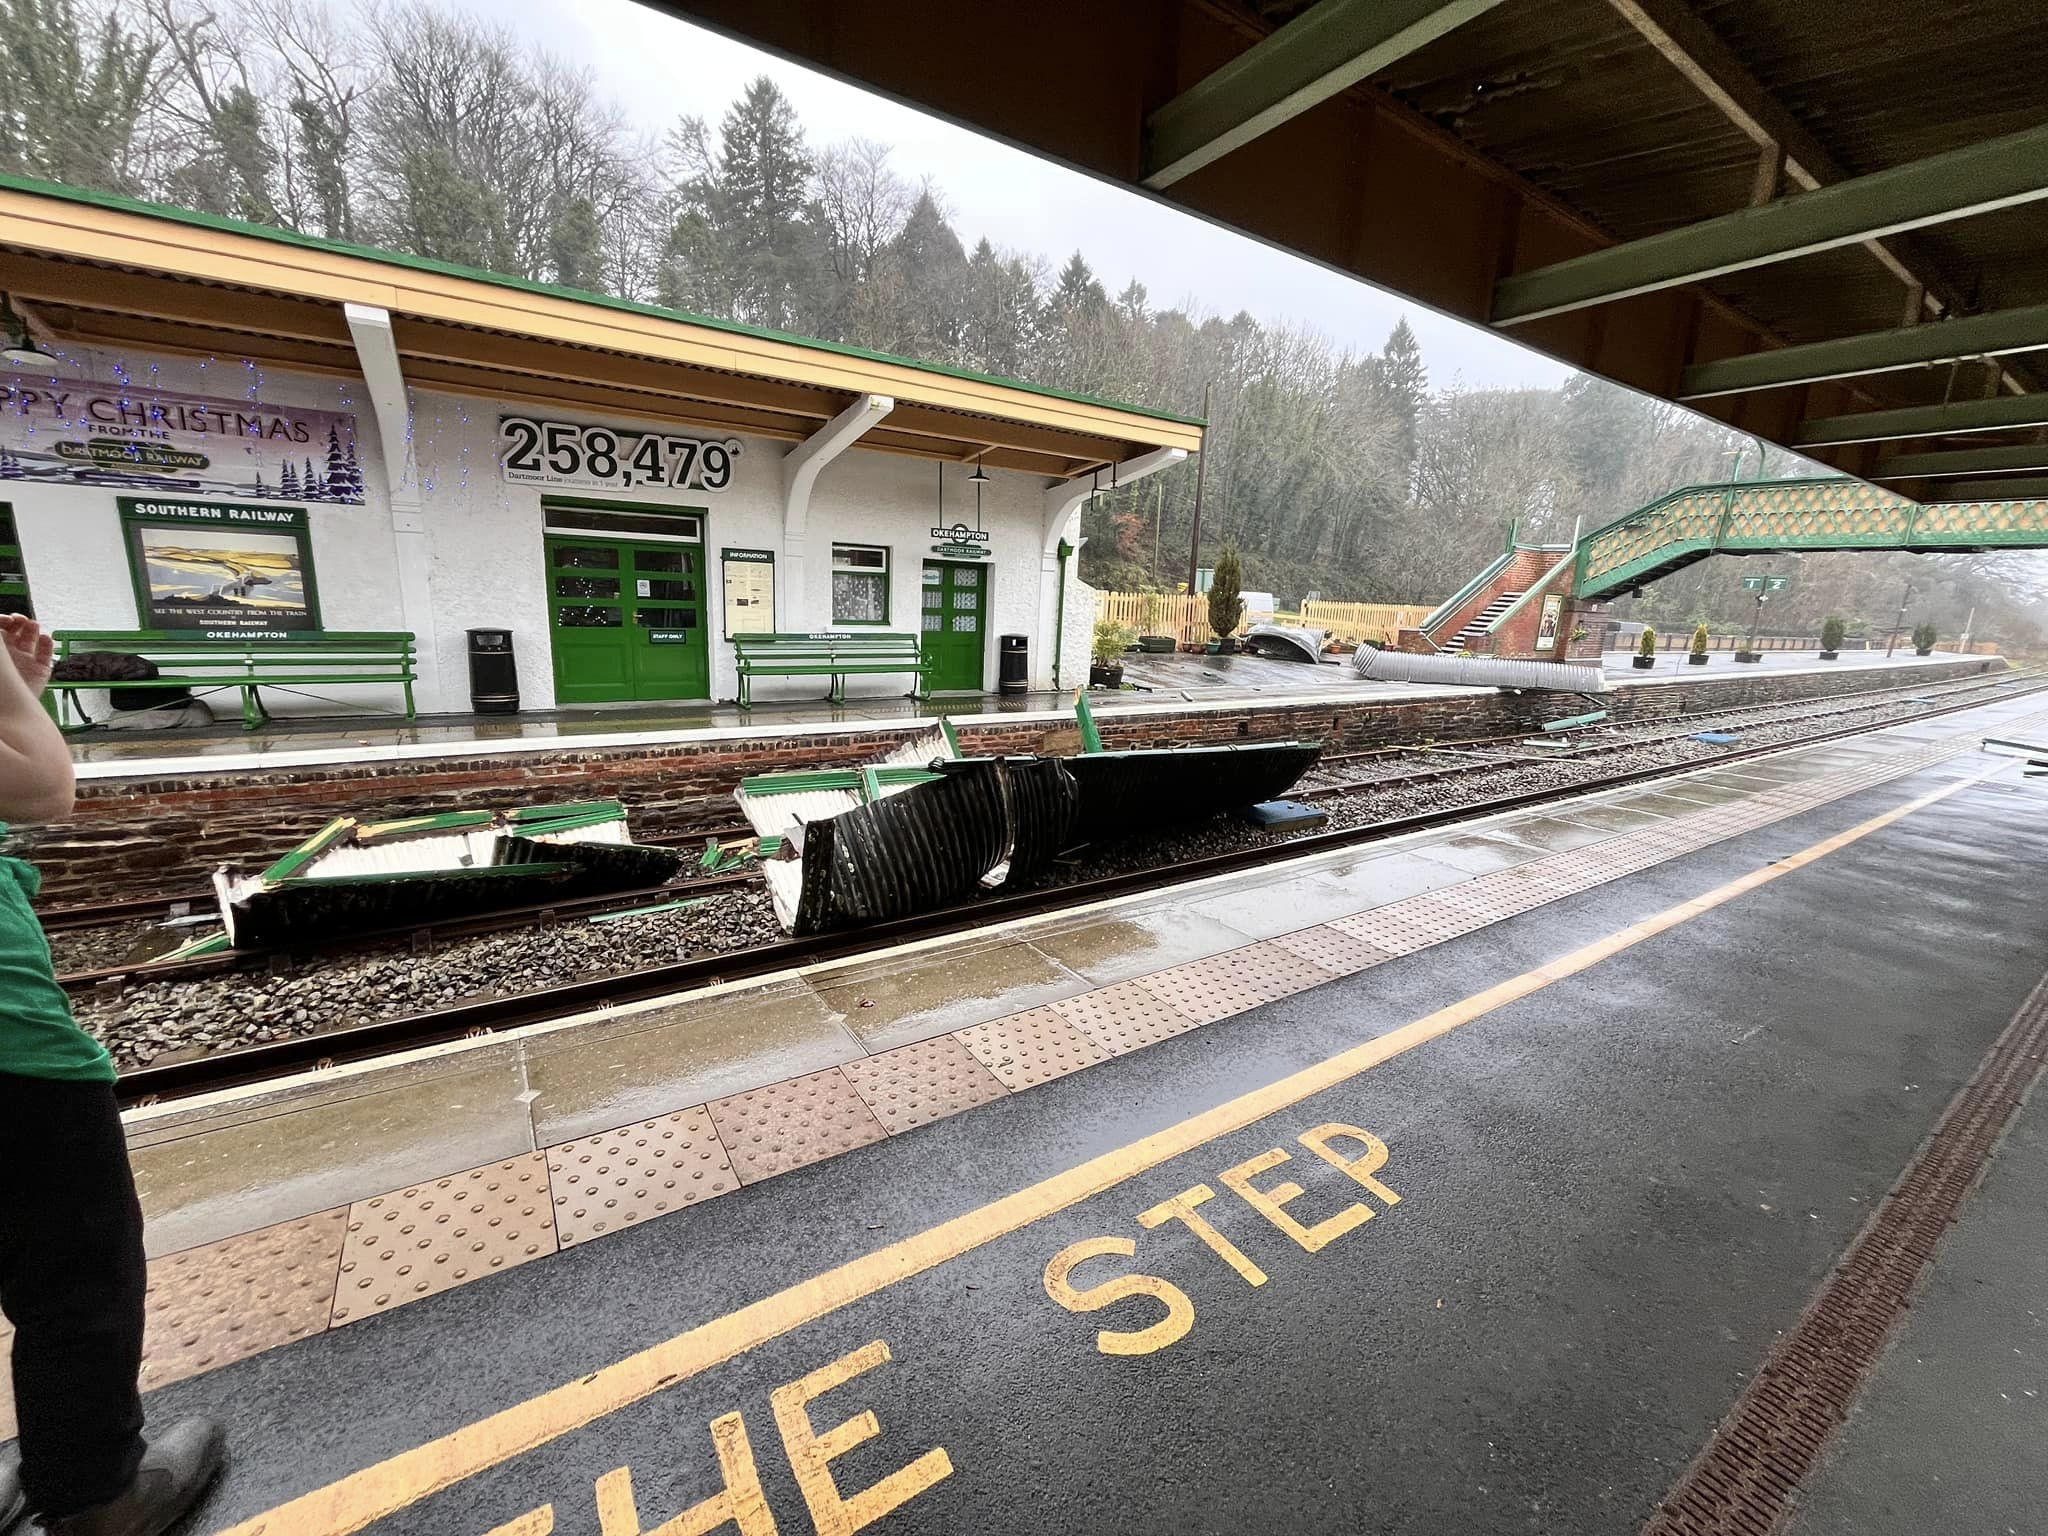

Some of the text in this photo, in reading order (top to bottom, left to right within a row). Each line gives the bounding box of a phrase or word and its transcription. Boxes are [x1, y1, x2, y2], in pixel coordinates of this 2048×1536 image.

[89, 398, 310, 443] CHRISTMAS
[88, 424, 171, 440] FROM THE
[504, 422, 731, 488] 258,479
[508, 471, 544, 481] Dartmoor
[546, 475, 563, 483] Line
[135, 503, 294, 522] SOUTHERN RAILWAY
[932, 529, 987, 540] OKEHAMPTON
[729, 551, 768, 559] INFORMATION
[1772, 581, 1781, 590] 2
[206, 631, 287, 639] OKEHAMPTON
[1043, 1122, 1402, 1357] STEP
